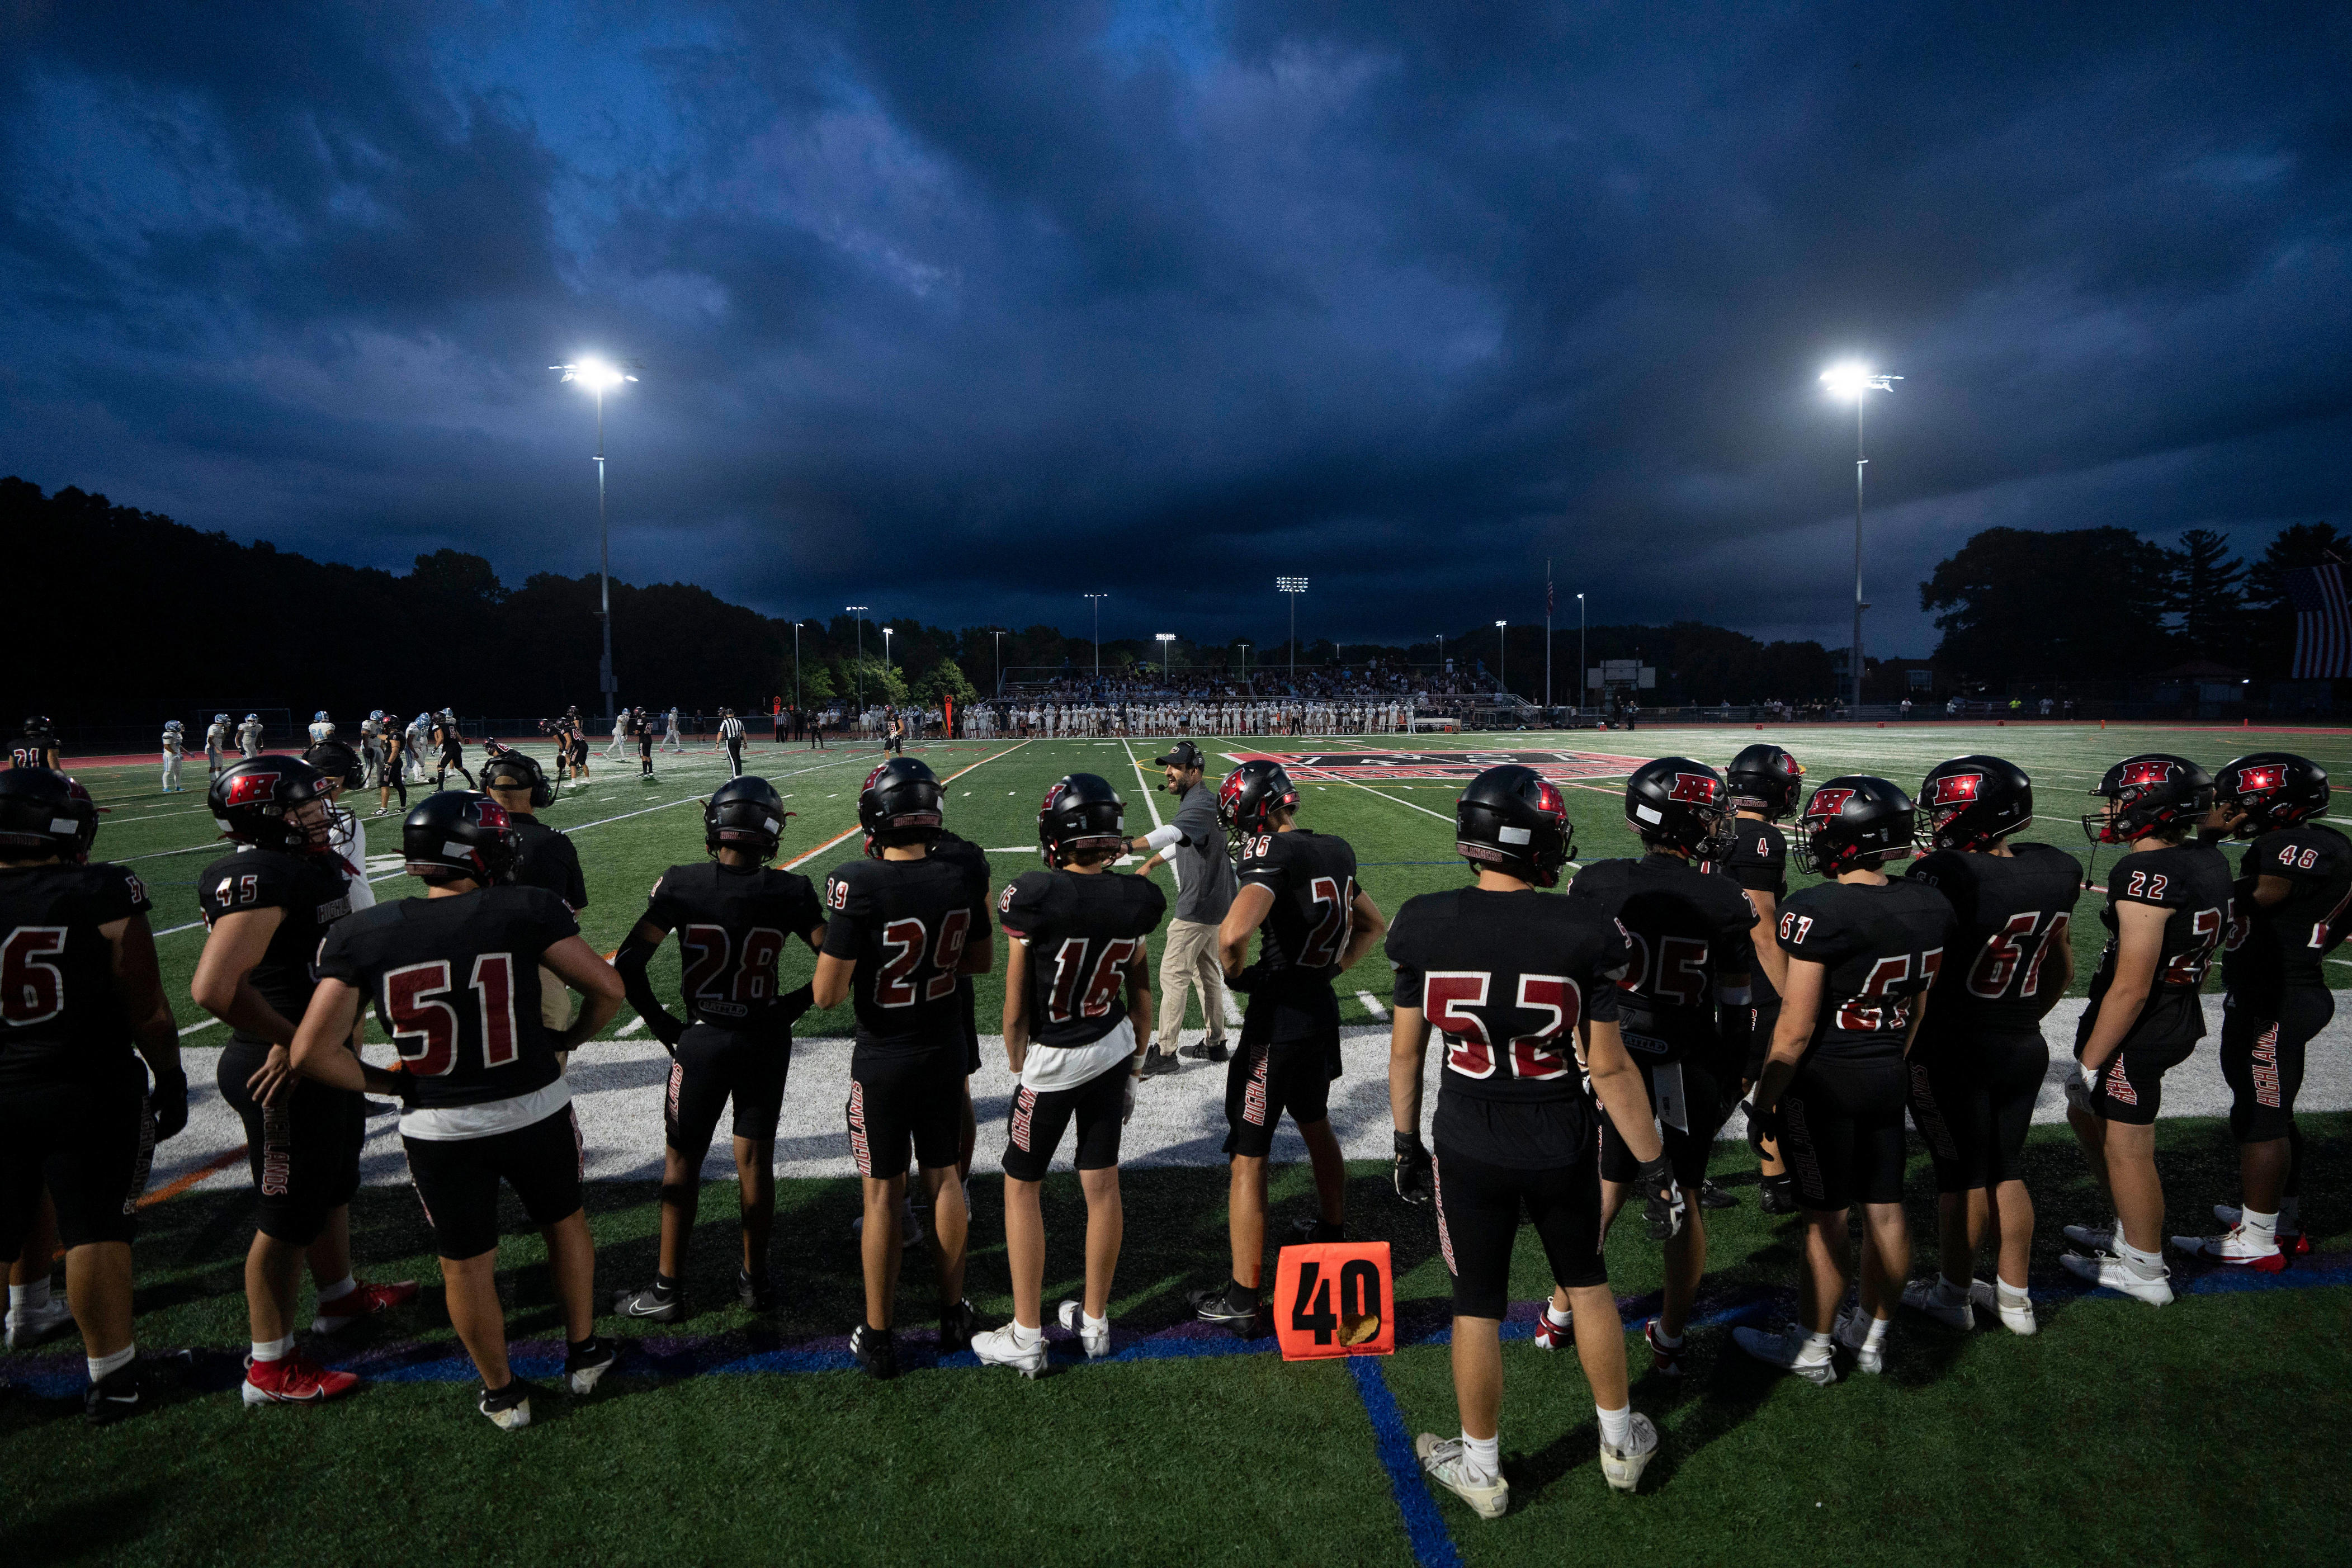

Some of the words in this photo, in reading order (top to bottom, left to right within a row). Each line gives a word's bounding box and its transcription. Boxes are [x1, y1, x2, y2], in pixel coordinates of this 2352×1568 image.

[1243, 835, 1272, 861] 26
[1756, 837, 1769, 858] 4
[2127, 870, 2168, 900] 22
[2278, 844, 2319, 870] 48
[216, 874, 258, 907] 45
[682, 923, 784, 1001] 28
[873, 907, 971, 1009] 29
[1049, 937, 1137, 1024] 16
[382, 952, 519, 1077] 51
[701, 1000, 744, 1016] BATTLE
[1423, 970, 1582, 1080] 52
[1623, 1035, 1663, 1051] ATTLE
[1242, 1043, 1271, 1127] HIGHLAND
[2251, 1020, 2280, 1108] HIGHLANDS
[848, 1078, 872, 1178] HIGHLANDS
[1292, 1259, 1382, 1346] 40
